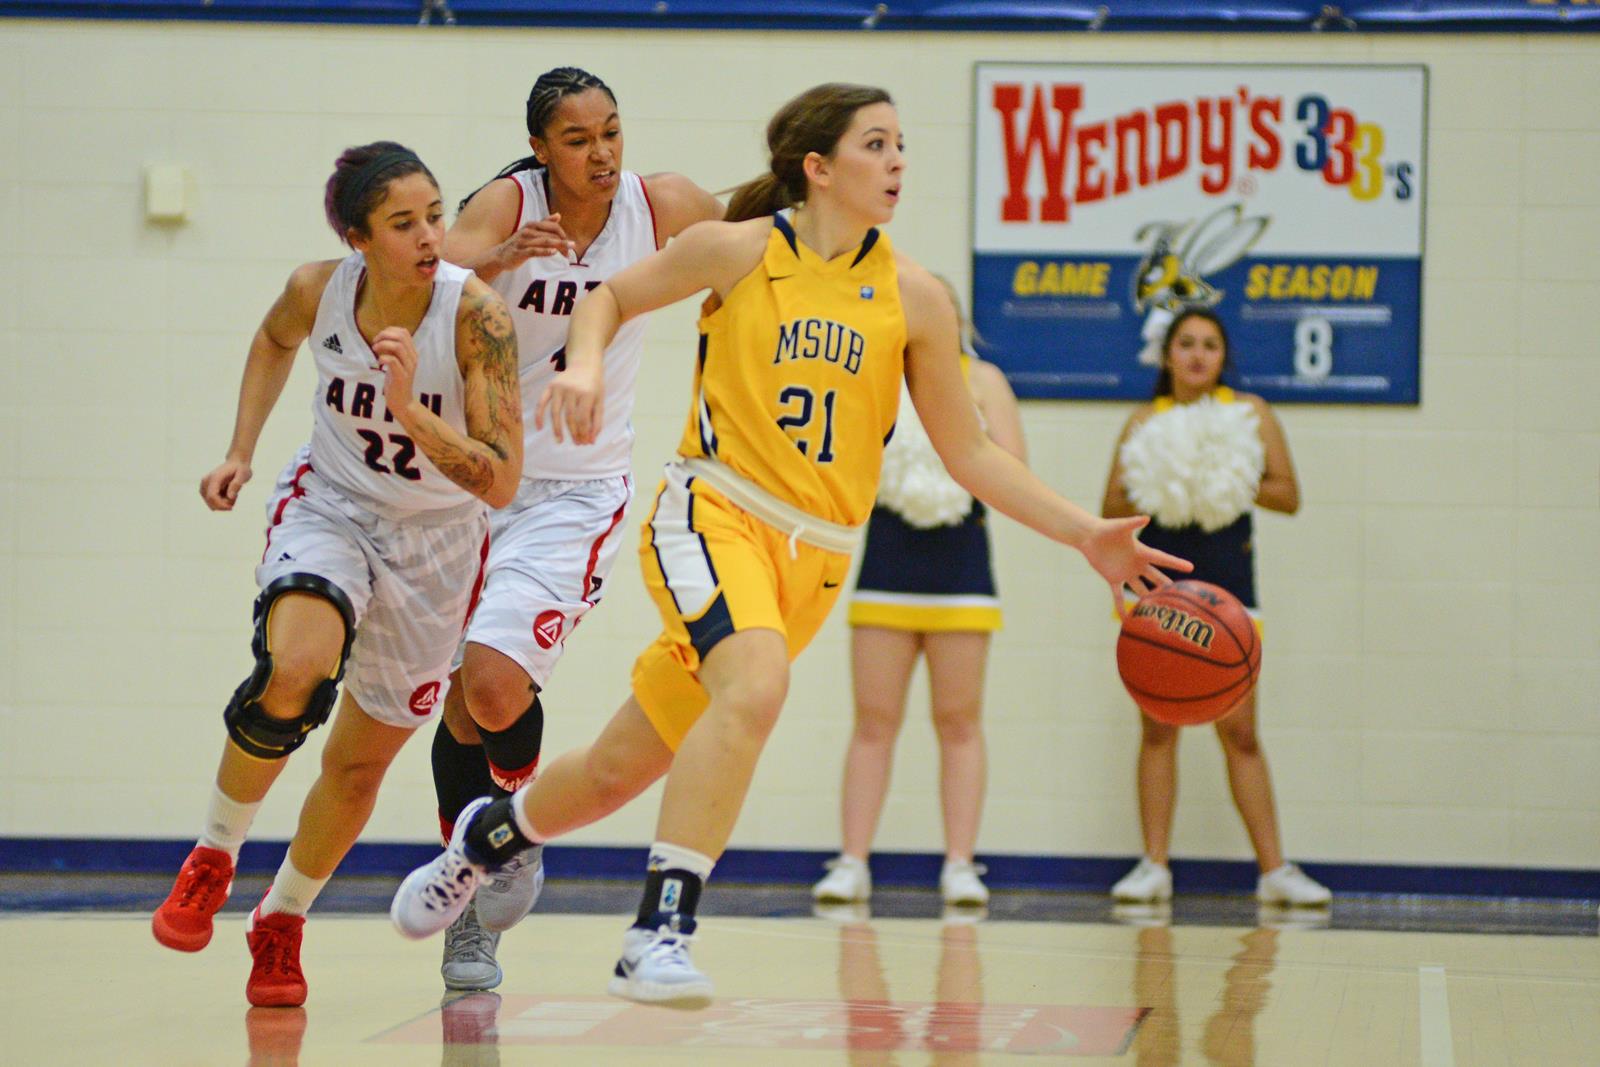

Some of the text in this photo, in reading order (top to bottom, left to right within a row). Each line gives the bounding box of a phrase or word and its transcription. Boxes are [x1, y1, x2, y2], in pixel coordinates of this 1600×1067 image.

[992, 83, 1281, 222] Wendy's
[1013, 263, 1111, 296] GAME
[1246, 265, 1379, 299] SEASON
[774, 319, 864, 375] MSUB
[1296, 319, 1332, 381] 8
[776, 387, 836, 462] 21
[356, 428, 421, 480] 22
[1133, 605, 1214, 649] Wilson
